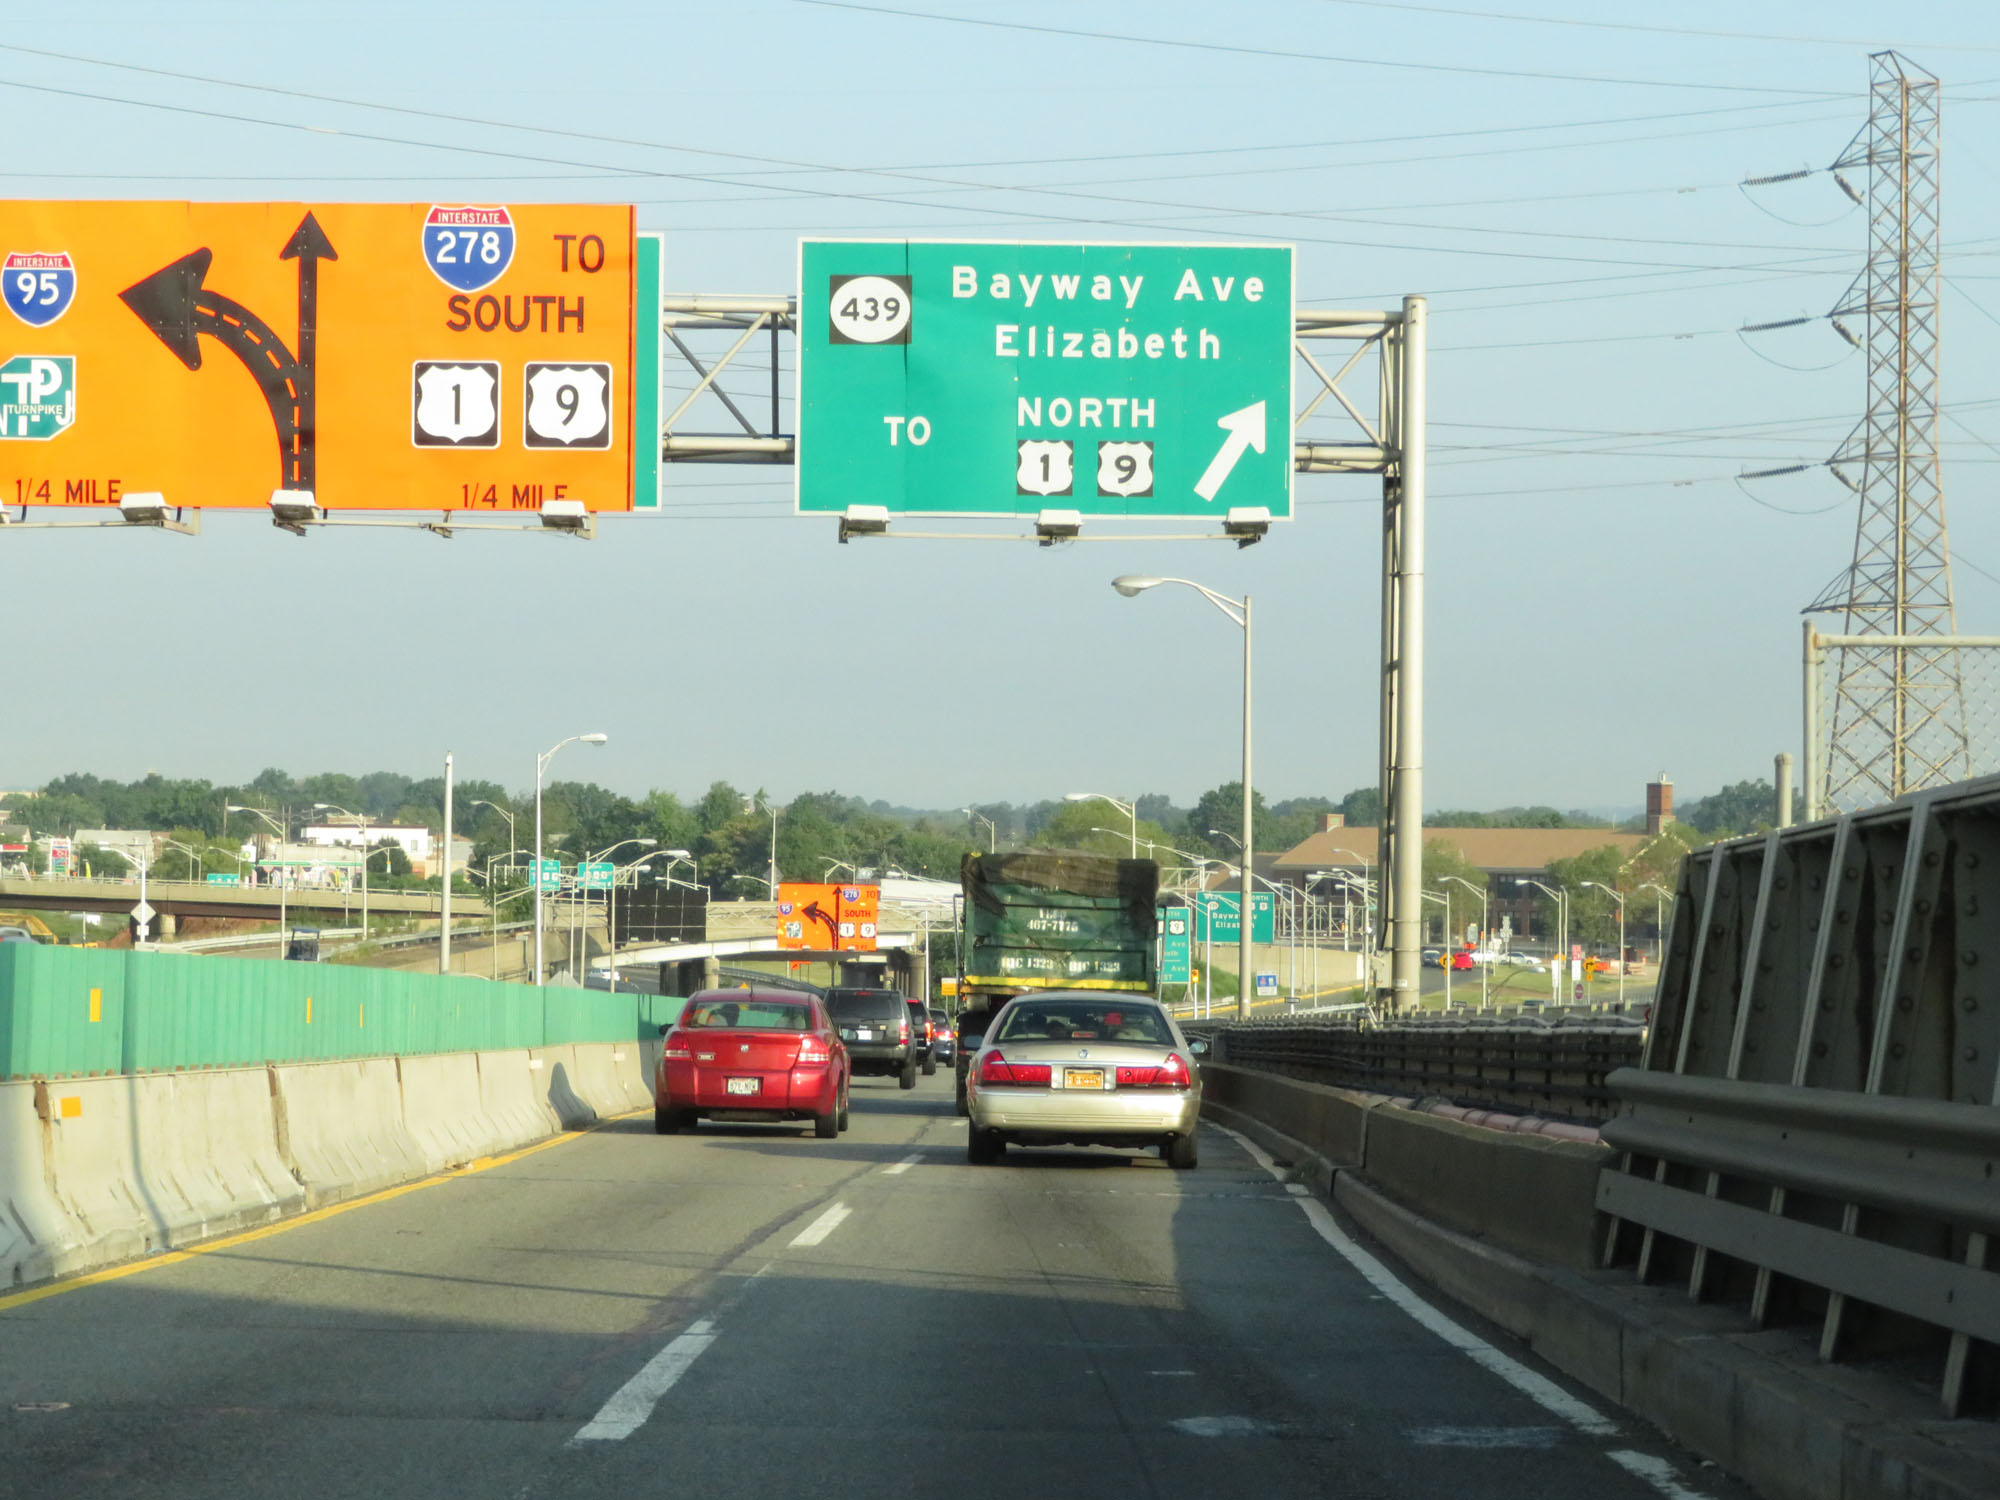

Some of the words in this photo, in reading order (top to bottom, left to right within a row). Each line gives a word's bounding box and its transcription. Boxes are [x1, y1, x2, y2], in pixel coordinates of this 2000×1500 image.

[438, 212, 500, 225] INTERSTATE
[13, 257, 64, 268] INTERSTATE
[436, 231, 501, 264] 278
[553, 234, 605, 273] TO
[16, 272, 60, 306] 95
[952, 265, 1144, 309] Bayway
[1173, 268, 1265, 302] Ave
[446, 294, 584, 333] SOUTH
[840, 297, 901, 322] 439
[995, 324, 1221, 360] Elizabeth
[8, 404, 63, 415] TURNPIKE
[452, 383, 461, 425] 1
[556, 384, 580, 426] 9
[1017, 397, 1155, 428] NORTH
[883, 416, 932, 446] TO
[1040, 453, 1050, 482] 1
[1114, 455, 1137, 484] 9
[16, 478, 51, 505] 1/4
[65, 479, 121, 504] MILE
[462, 482, 498, 508] 1/4
[866, 891, 876, 899] TO
[844, 909, 871, 918] SOUTH
[865, 926, 871, 935] 9
